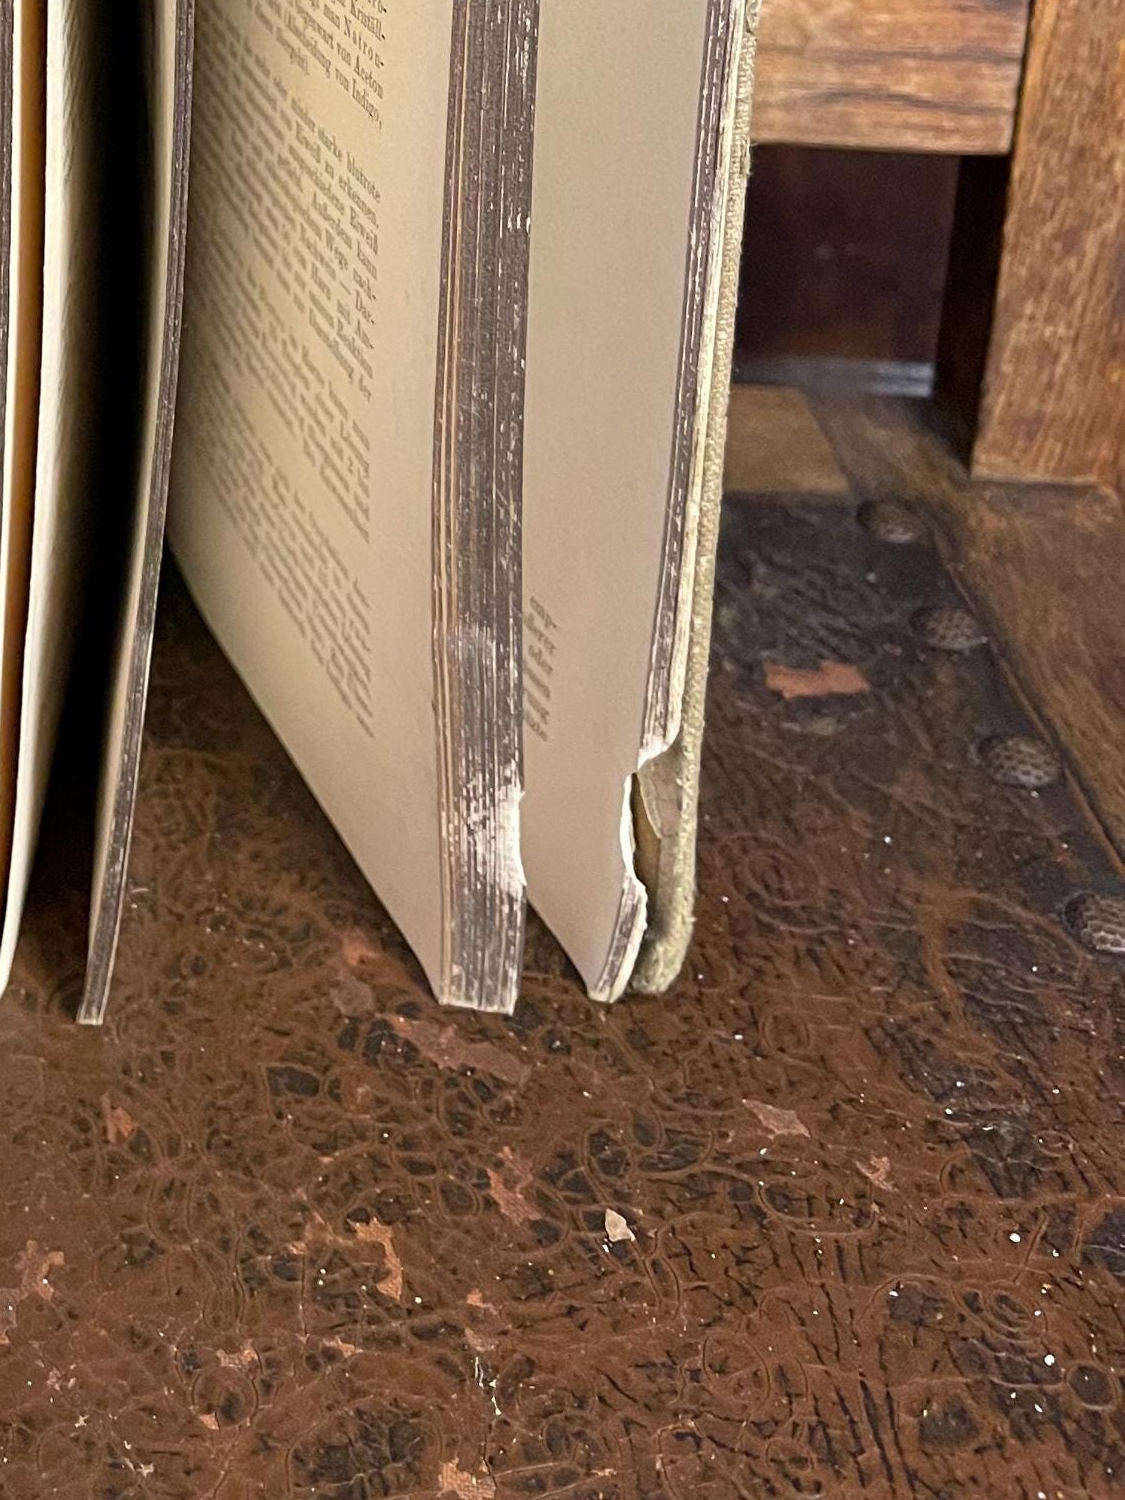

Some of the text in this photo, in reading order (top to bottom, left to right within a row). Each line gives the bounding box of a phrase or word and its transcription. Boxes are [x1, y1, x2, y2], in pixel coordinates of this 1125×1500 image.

[343, 15, 384, 68] Natron-
[335, 67, 349, 91] von
[352, 78, 381, 131] Indigo,
[336, 43, 351, 67] von
[354, 55, 383, 99] Aceton
